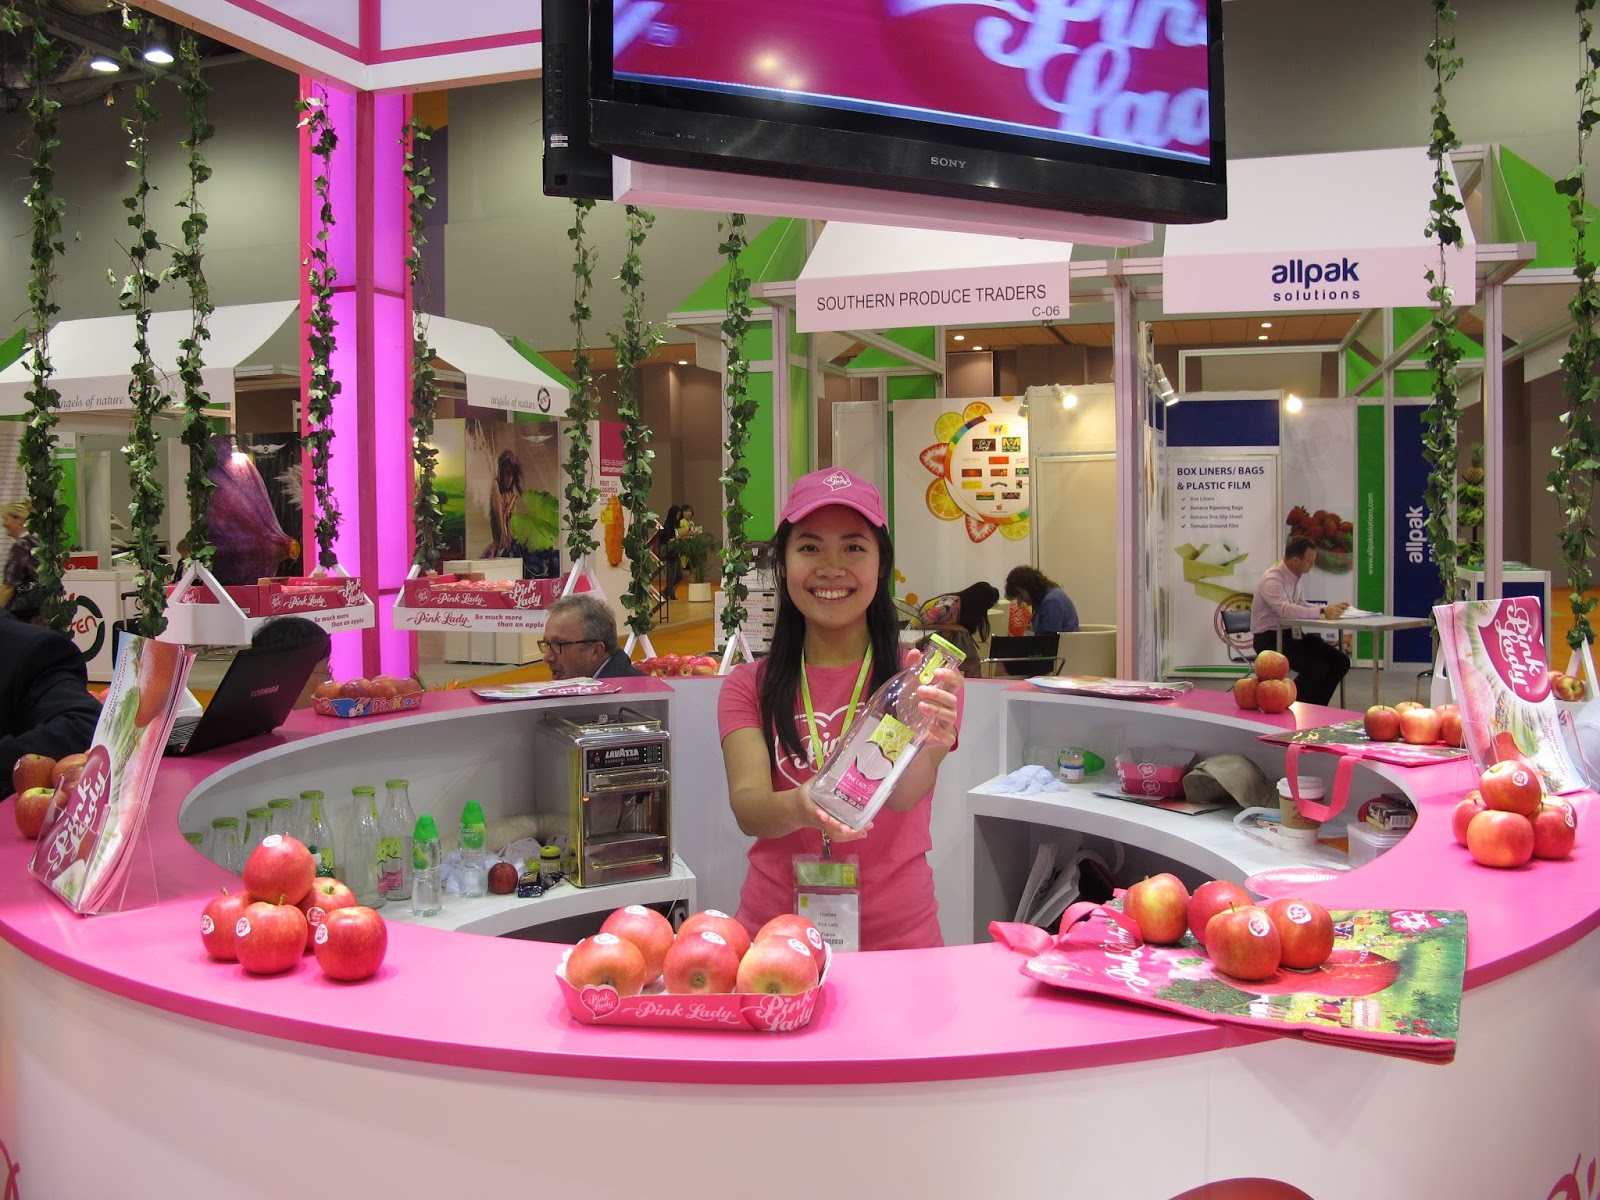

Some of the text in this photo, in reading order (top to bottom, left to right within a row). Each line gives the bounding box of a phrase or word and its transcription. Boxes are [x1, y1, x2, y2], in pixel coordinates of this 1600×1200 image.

[930, 156, 966, 169] SONY
[1271, 257, 1361, 289] allpak
[816, 284, 1046, 311] SOUTHERN PRODUCE TRADERS
[1273, 290, 1361, 302] solutions
[1032, 306, 1060, 317] C-06
[59, 394, 124, 410] ngels of nature
[490, 395, 510, 408] angels
[511, 397, 518, 409] of
[518, 400, 536, 410] nature
[1177, 466, 1264, 476] BOX LINERS/ BAGS
[1176, 481, 1251, 490] & PLASTIC FILM
[1405, 505, 1428, 564] allpak
[509, 580, 538, 599] Pink
[283, 594, 327, 609] Pink Lady
[432, 592, 487, 607] Pink Lady
[513, 594, 542, 610] Lady
[350, 619, 364, 628] apple
[408, 612, 472, 628] Pink Lady
[525, 621, 544, 629] apple
[1506, 603, 1544, 677] Pink
[1494, 618, 1528, 692] Lady
[250, 684, 280, 698] TOSHIBA
[605, 748, 640, 759] LAVAZZA
[47, 775, 92, 872] Pink
[68, 771, 109, 862] Lady
[588, 994, 611, 1004] Pink
[592, 998, 614, 1010] Lady
[755, 994, 814, 1019] Pink
[632, 1002, 740, 1024] Pink Lady
[763, 1006, 813, 1032] Lady
